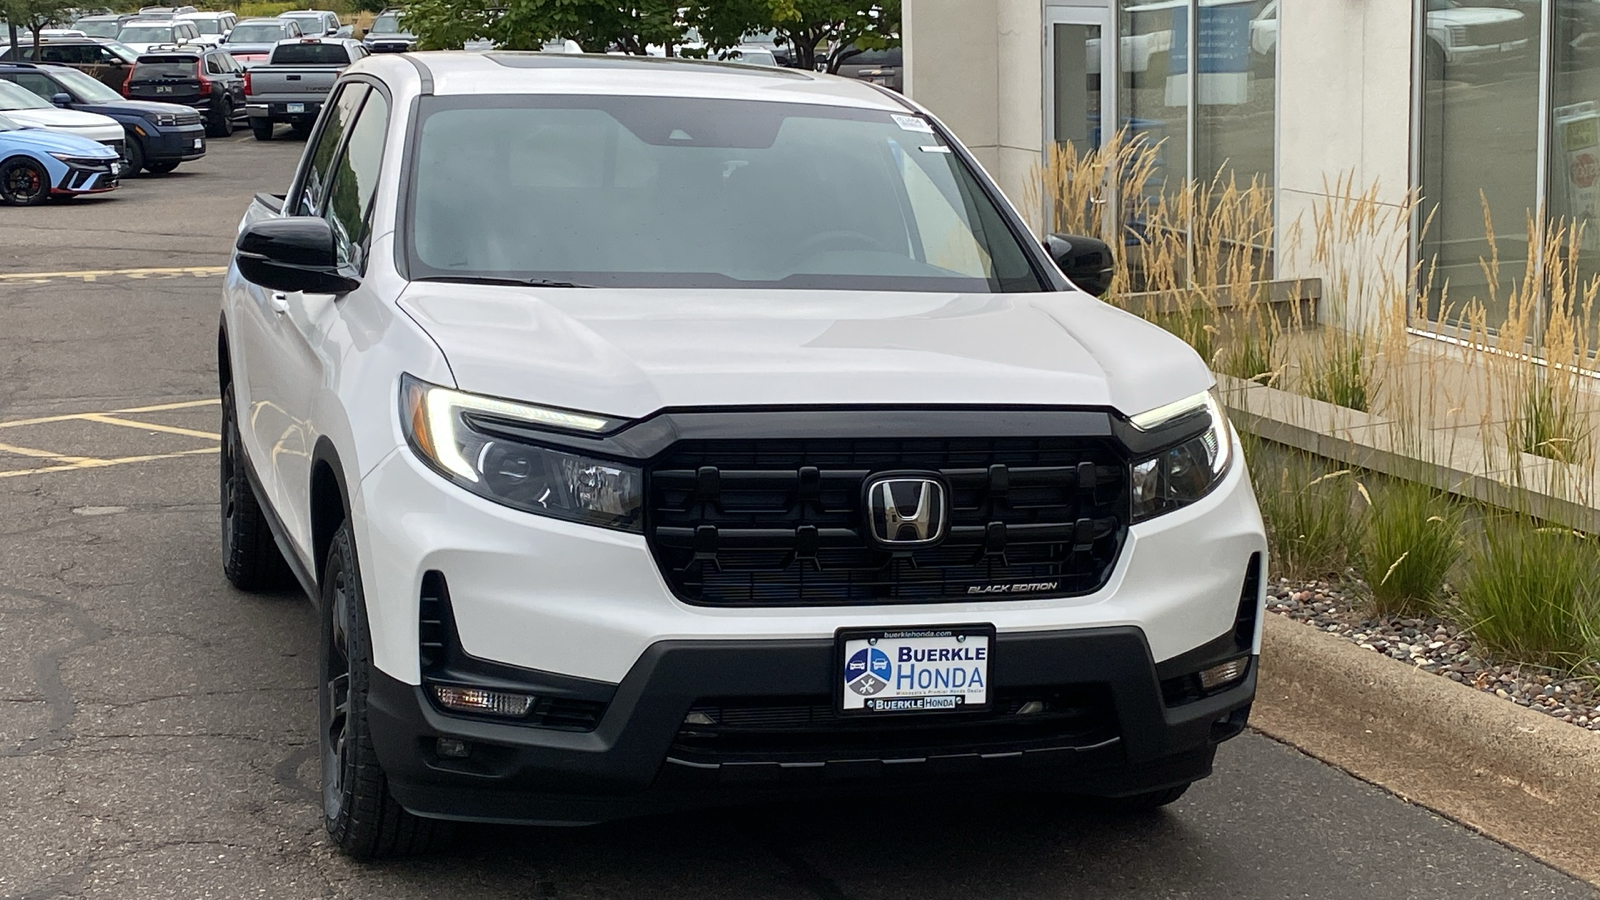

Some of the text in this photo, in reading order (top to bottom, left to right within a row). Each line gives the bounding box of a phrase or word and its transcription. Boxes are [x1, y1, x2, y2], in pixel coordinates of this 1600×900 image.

[967, 582, 1058, 594] BLACK EDITION
[898, 646, 986, 663] BUERKLE
[896, 663, 984, 690] HONDA
[875, 698, 954, 710] BUERKLE HONDA
